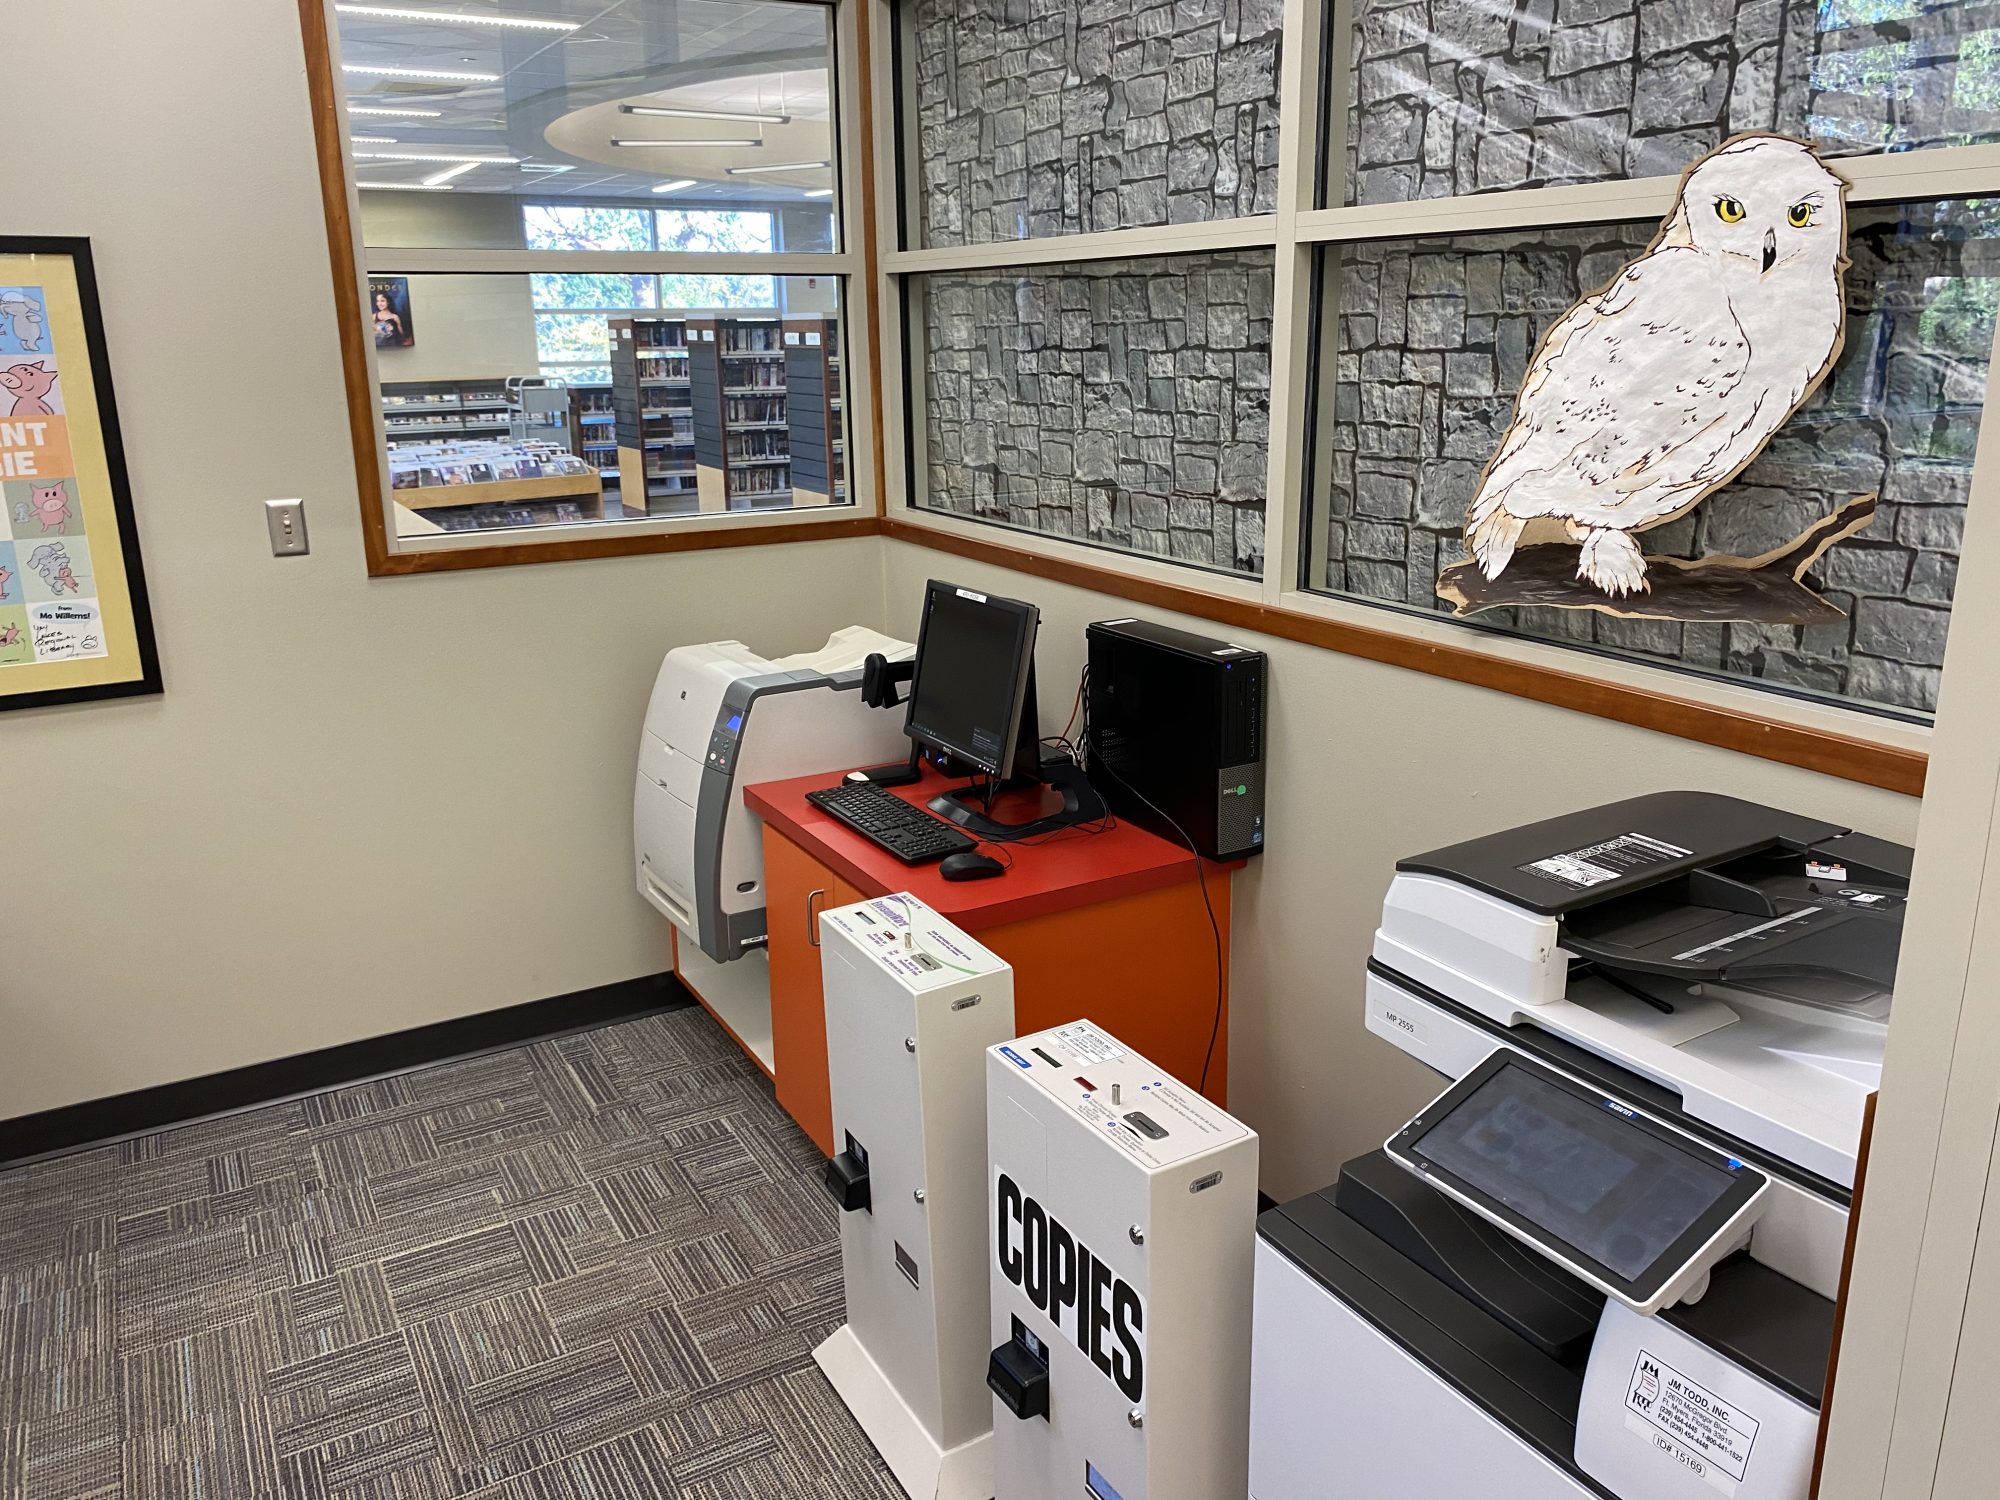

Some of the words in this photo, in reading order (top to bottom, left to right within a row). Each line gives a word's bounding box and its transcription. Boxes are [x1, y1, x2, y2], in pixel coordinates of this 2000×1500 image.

[0, 422, 47, 447] NT
[0, 451, 38, 477] IE
[1386, 1011, 1397, 1022] MP
[1398, 1018, 1414, 1032] 2555
[1608, 1102, 1633, 1117] savin
[998, 1173, 1143, 1403] COPIES
[1640, 1360, 1659, 1378] JM
[1665, 1390, 1683, 1405] 12670
[1684, 1401, 1713, 1424] McGregor
[1668, 1378, 1681, 1391] JM
[1683, 1386, 1710, 1411] TODD,
[1711, 1405, 1730, 1423] INC.
[1658, 1412, 1669, 1425] FAX
[1671, 1402, 1690, 1419] Myers,
[1691, 1415, 1712, 1433] Florida
[1713, 1429, 1732, 1446] 33919
[1656, 1437, 1672, 1452] ID#
[1675, 1450, 1702, 1473] 15169
[1701, 1432, 1743, 1463] 1-800-441-1522
